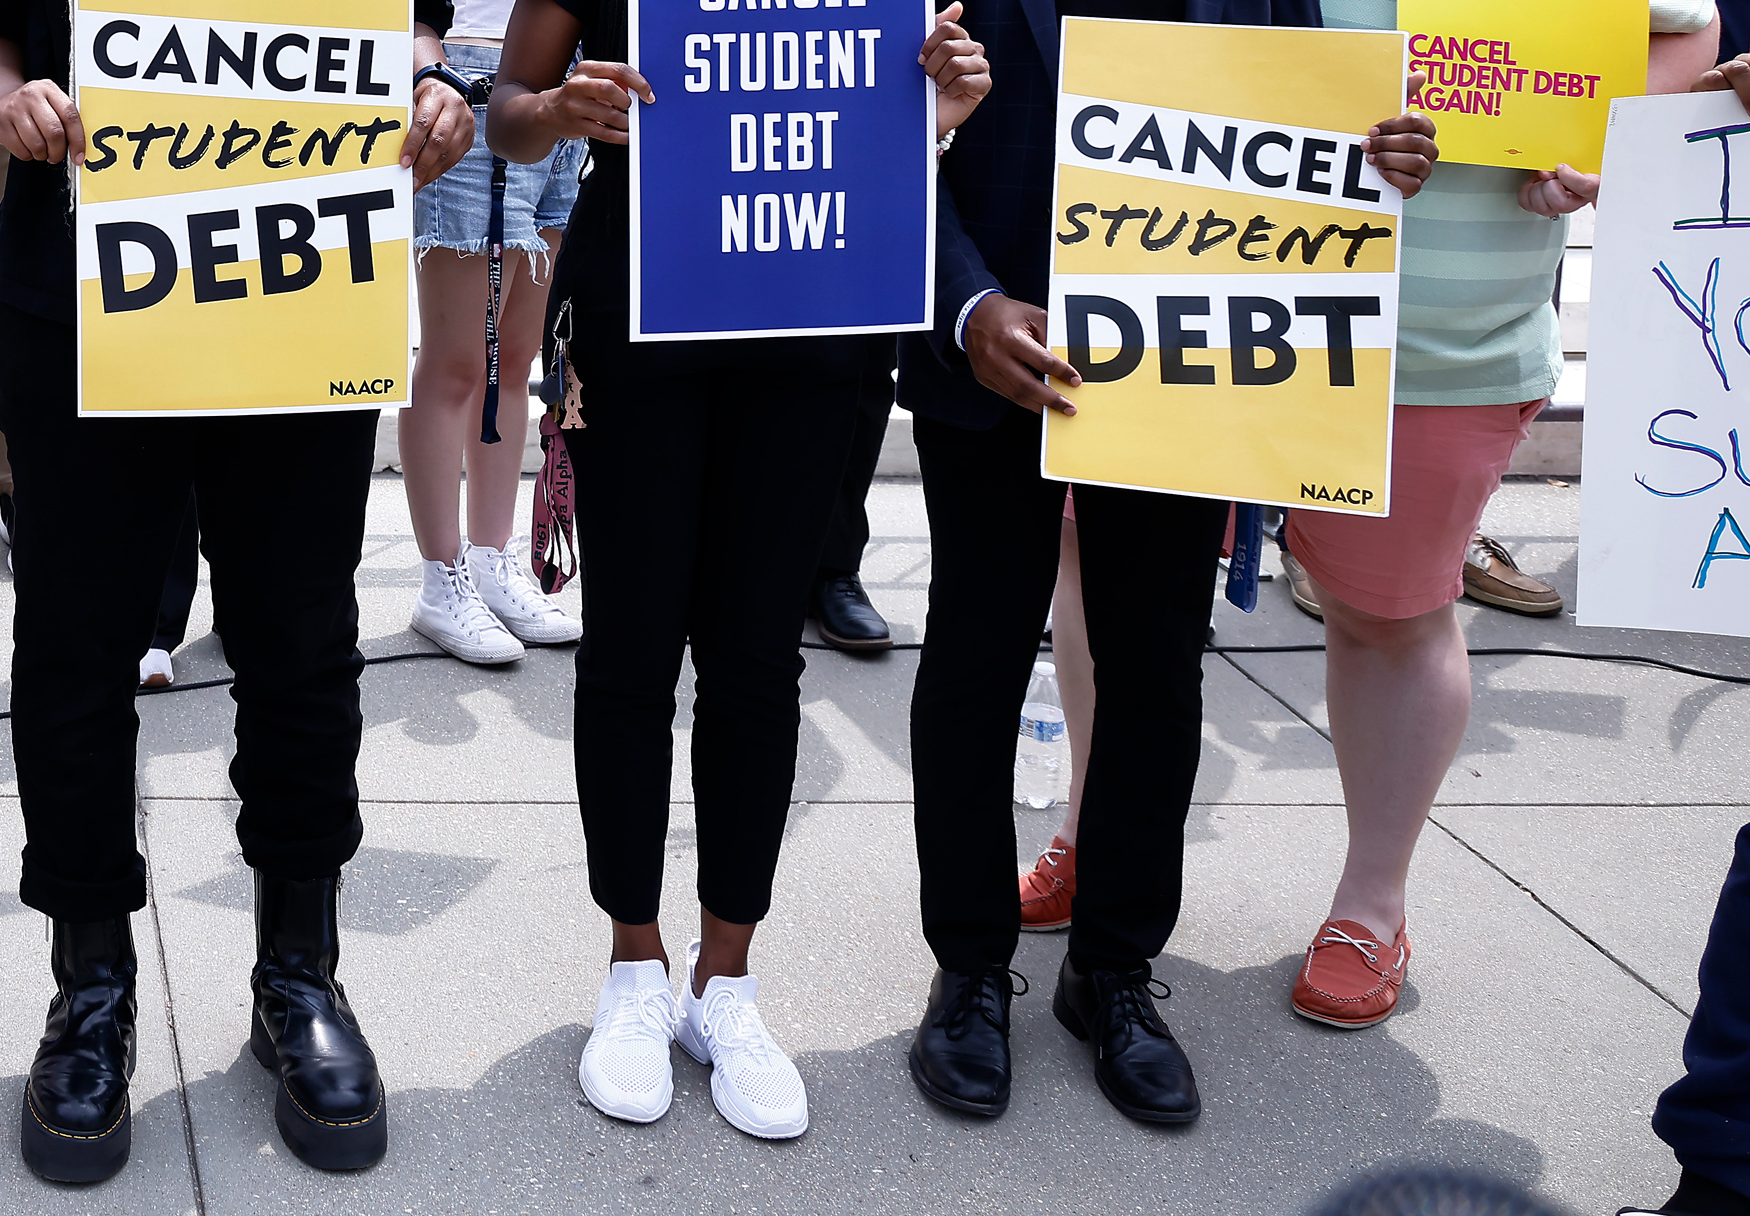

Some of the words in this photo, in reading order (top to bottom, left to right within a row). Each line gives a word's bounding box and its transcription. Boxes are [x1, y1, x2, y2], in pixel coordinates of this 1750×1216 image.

[92, 19, 391, 97] CANCEL
[684, 28, 882, 93] STUDENT
[1408, 34, 1516, 66] CANCEL
[1408, 59, 1529, 93] STUDENT
[1533, 69, 1601, 100] DEBT
[1407, 88, 1502, 117] AGAIN!
[85, 118, 402, 174] STUDENT
[730, 111, 839, 172] DEBT
[1070, 104, 1382, 203] CANCEL
[94, 189, 395, 315] DEBT
[721, 190, 847, 253] NOW!
[1056, 202, 1393, 268] STUDENT
[1064, 294, 1381, 388] DEBT
[1652, 255, 1750, 392] Y
[329, 378, 395, 397] NAACP
[555, 448, 568, 499] Alpha
[1300, 482, 1375, 507] NAACP
[1233, 541, 1248, 582] 1914
